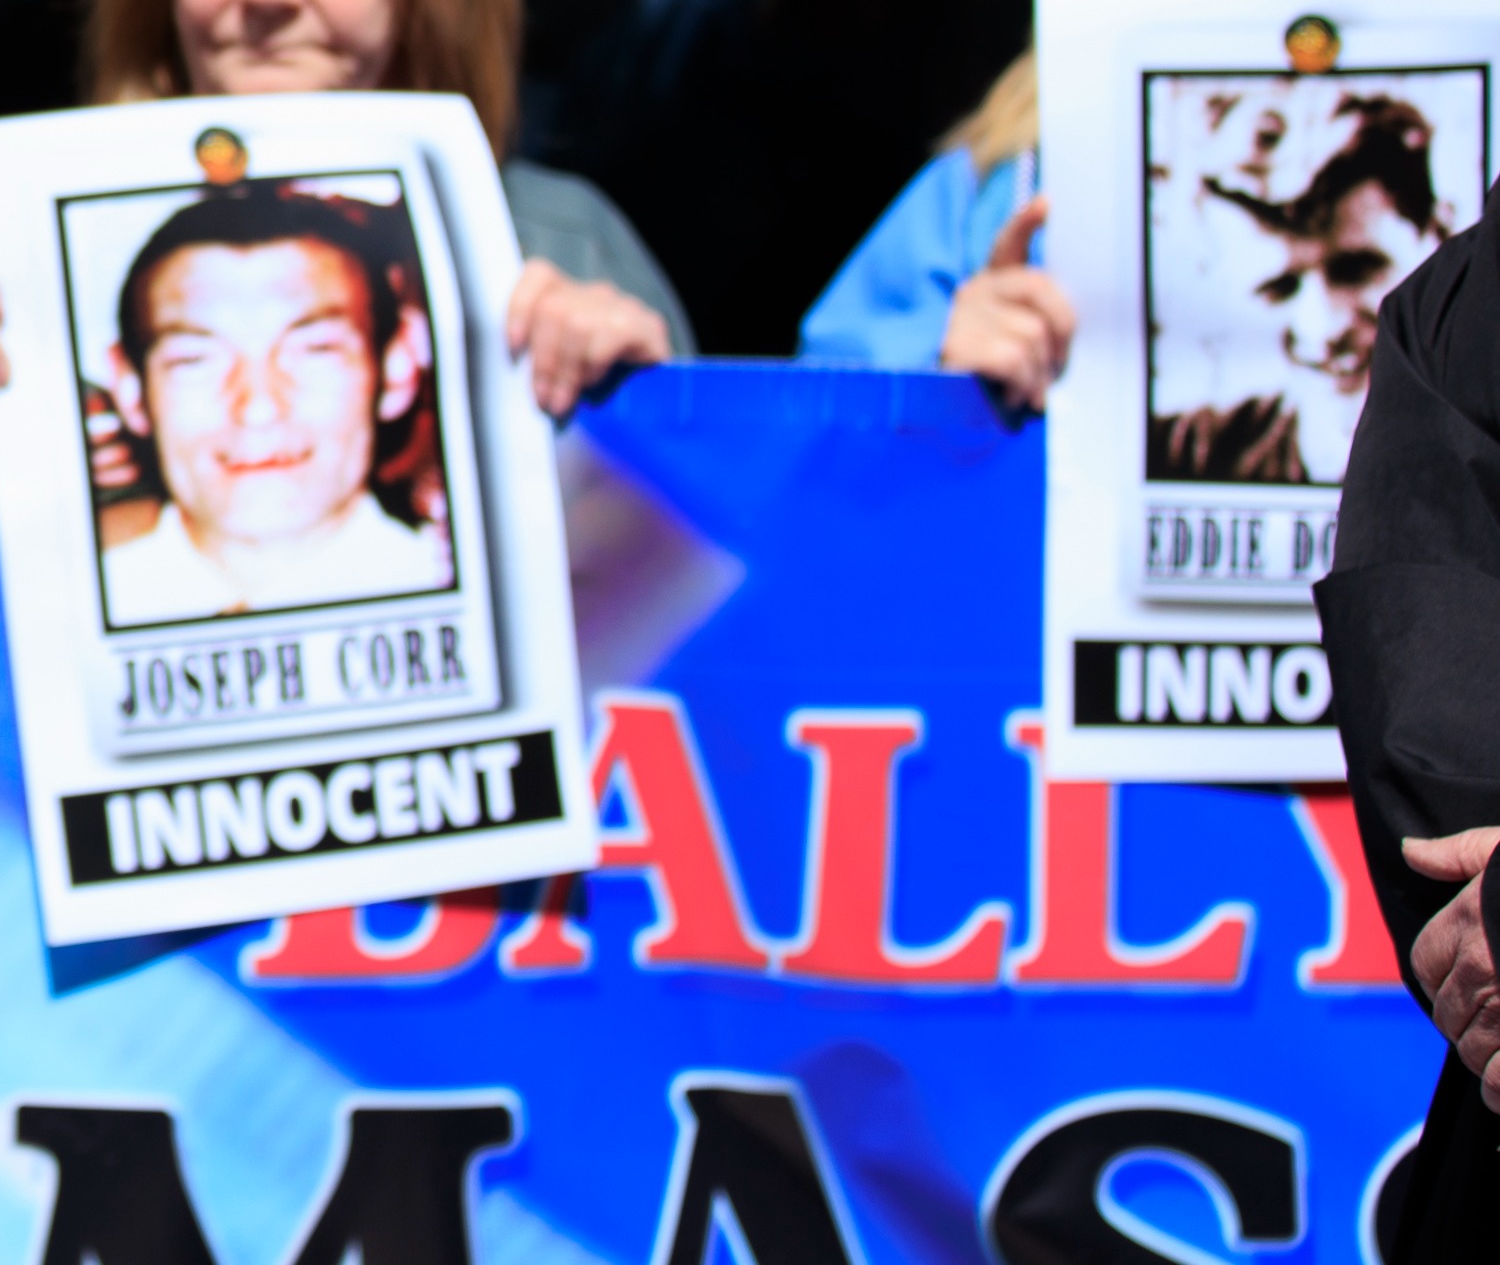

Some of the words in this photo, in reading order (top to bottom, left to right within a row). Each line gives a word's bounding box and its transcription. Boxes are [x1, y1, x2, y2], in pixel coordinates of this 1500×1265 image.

[1146, 516, 1263, 570] EDDIE
[120, 641, 304, 718] JOSEPH
[338, 624, 467, 693] CORR
[104, 740, 522, 874] INNOCENT
[240, 691, 1404, 989] ALL
